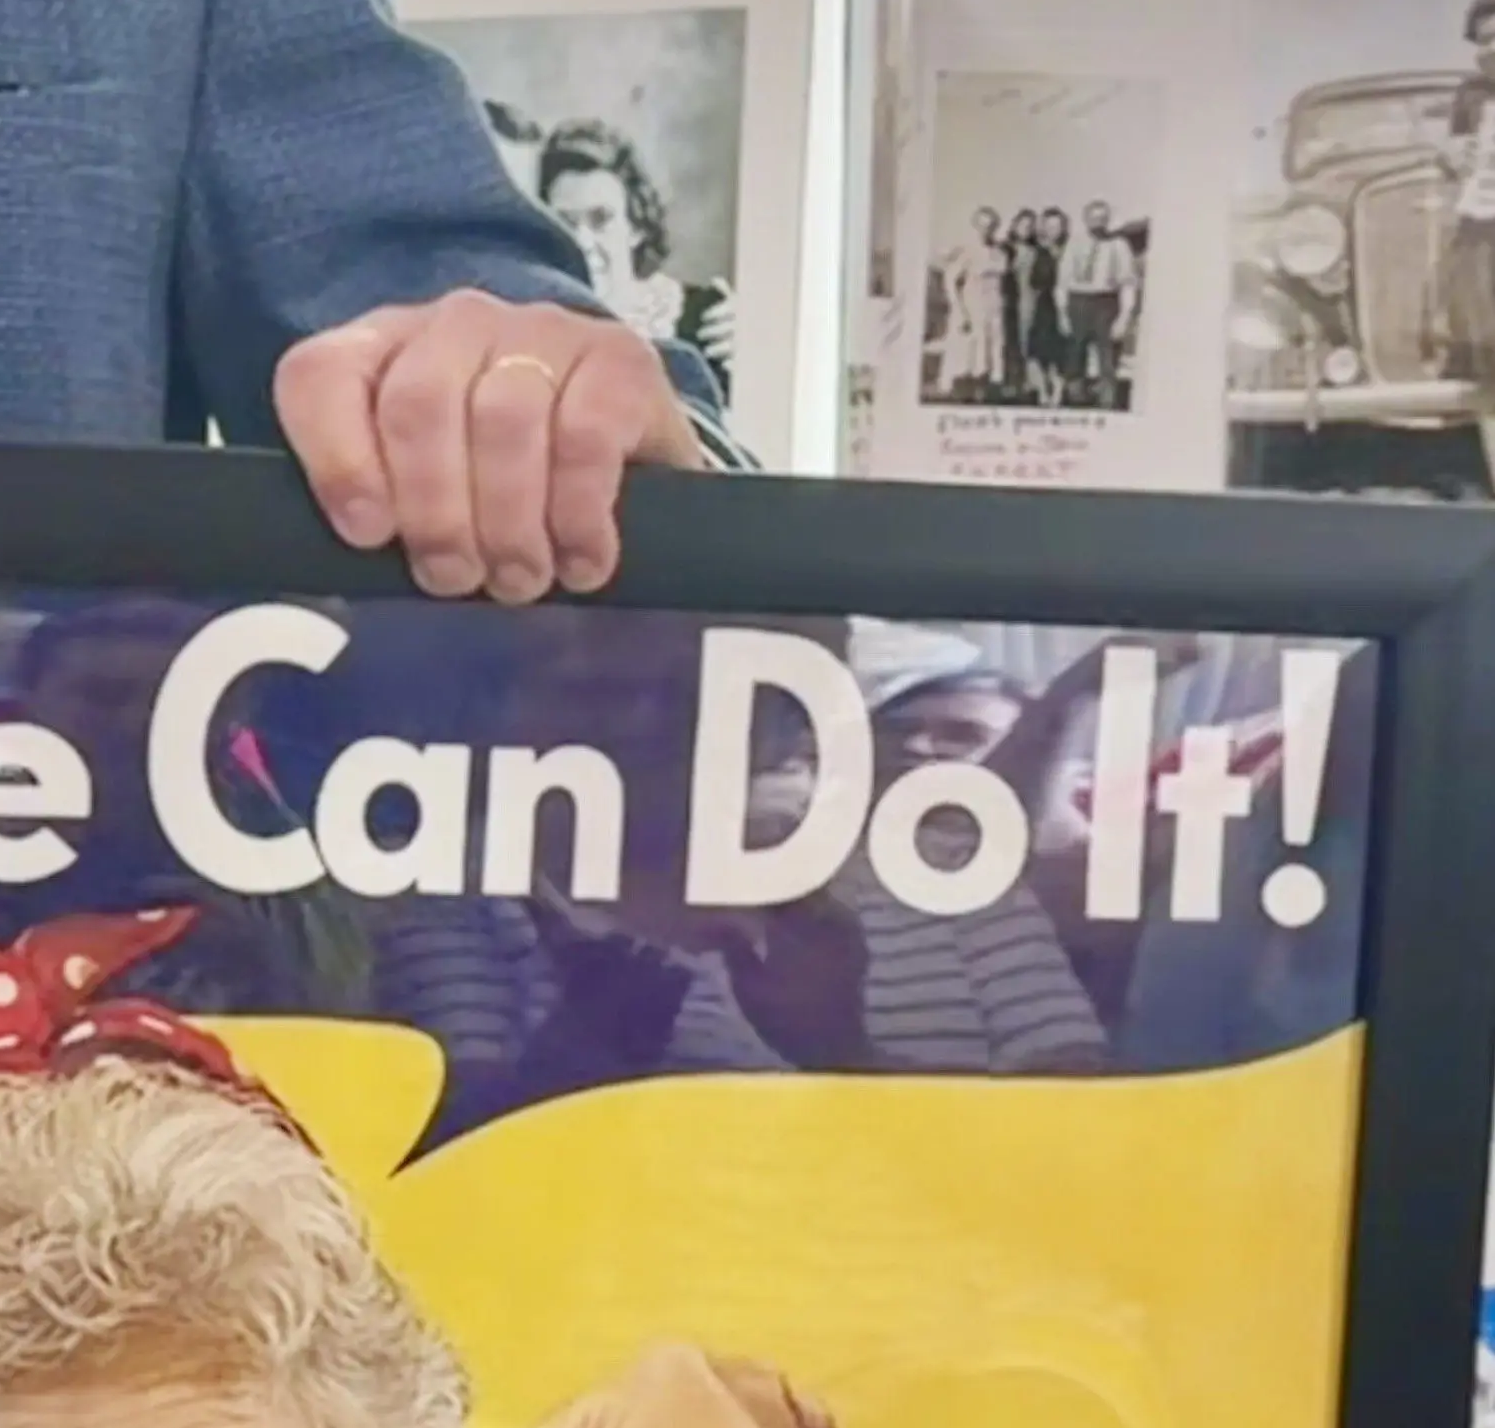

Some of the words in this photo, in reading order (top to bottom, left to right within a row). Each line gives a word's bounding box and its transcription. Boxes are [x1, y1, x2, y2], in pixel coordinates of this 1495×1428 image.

[147, 602, 626, 901] Can
[684, 627, 1029, 916] Do
[1085, 645, 1341, 928] It!
